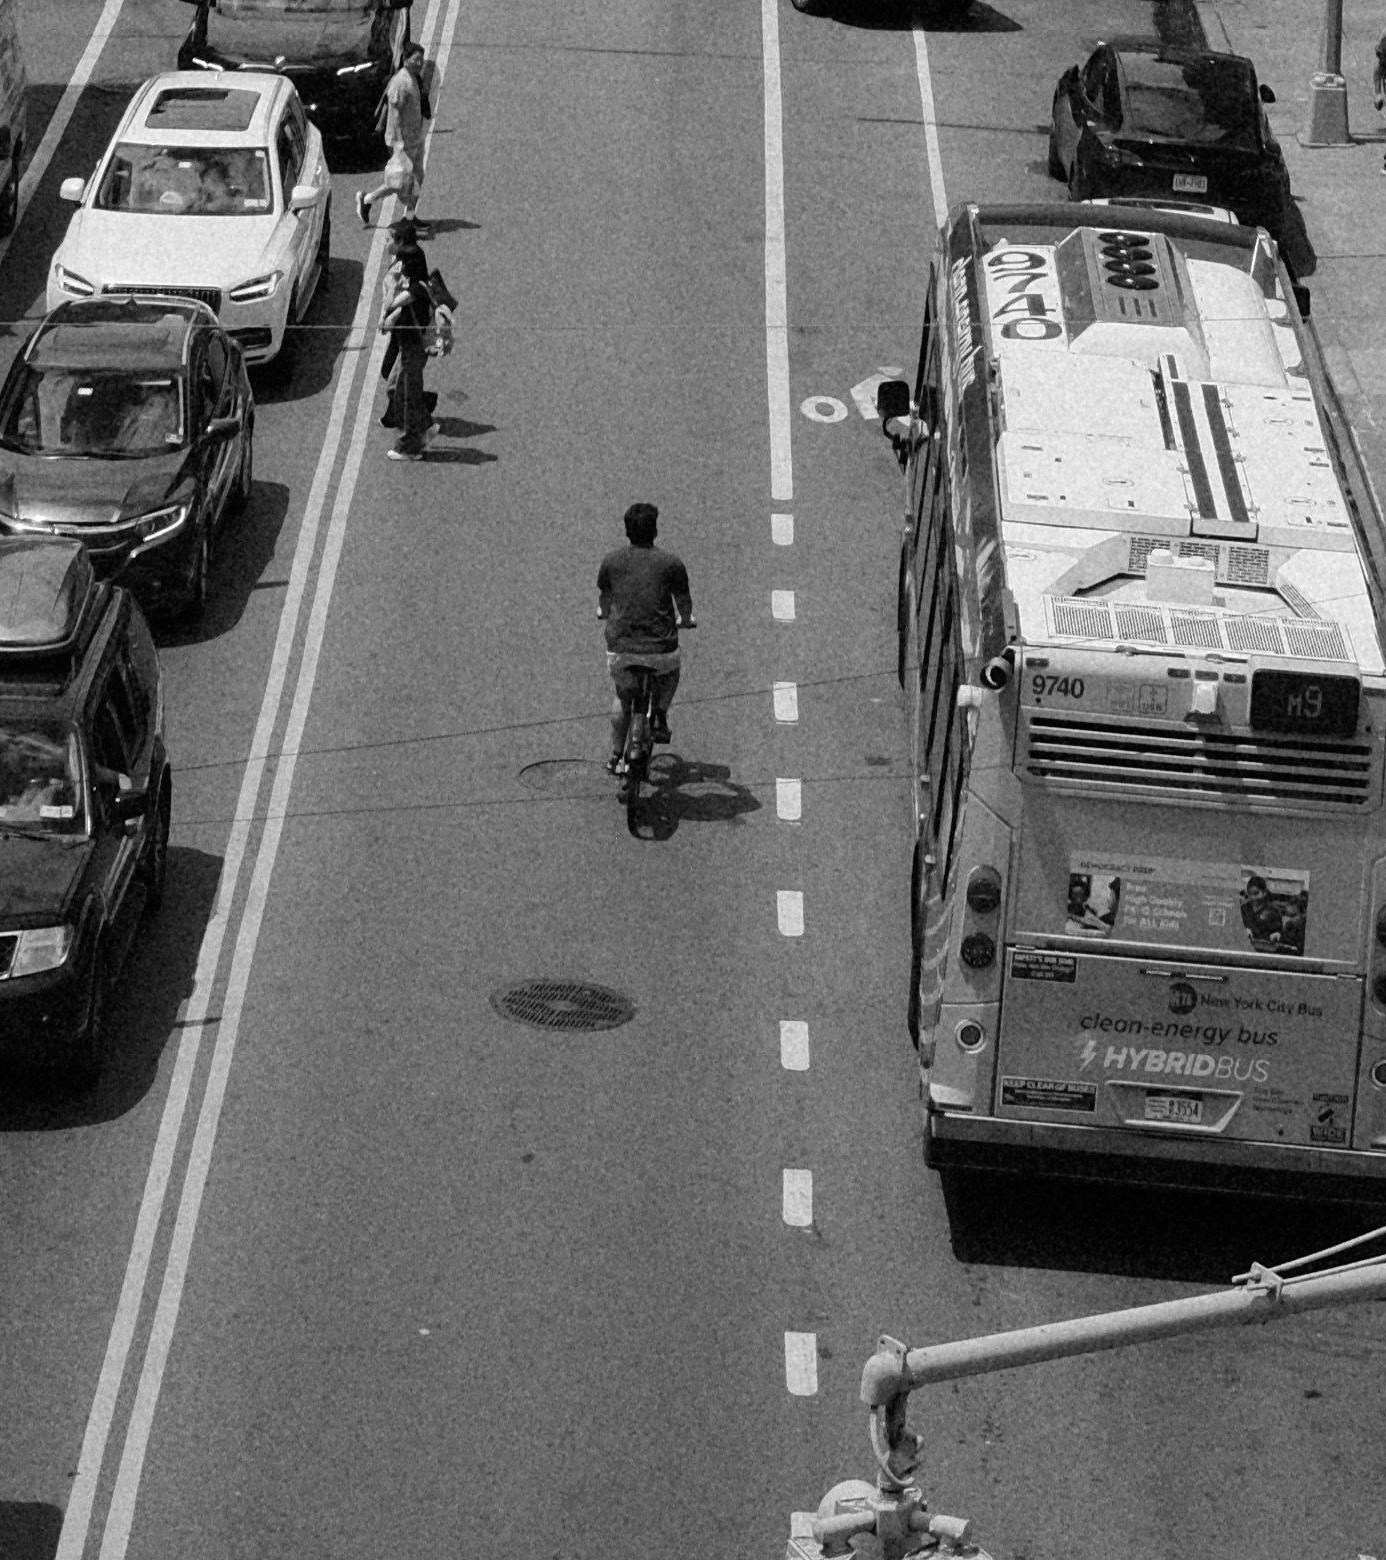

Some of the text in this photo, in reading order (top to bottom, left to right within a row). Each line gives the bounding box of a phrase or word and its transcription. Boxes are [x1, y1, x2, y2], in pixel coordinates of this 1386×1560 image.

[1031, 674, 1085, 699] 9740
[1287, 685, 1323, 719] M9
[1201, 994, 1230, 1008] New
[1234, 996, 1263, 1012] York
[1266, 999, 1295, 1016] City
[1298, 1002, 1323, 1017] Bus
[1080, 1013, 1279, 1046] clean-energy bus
